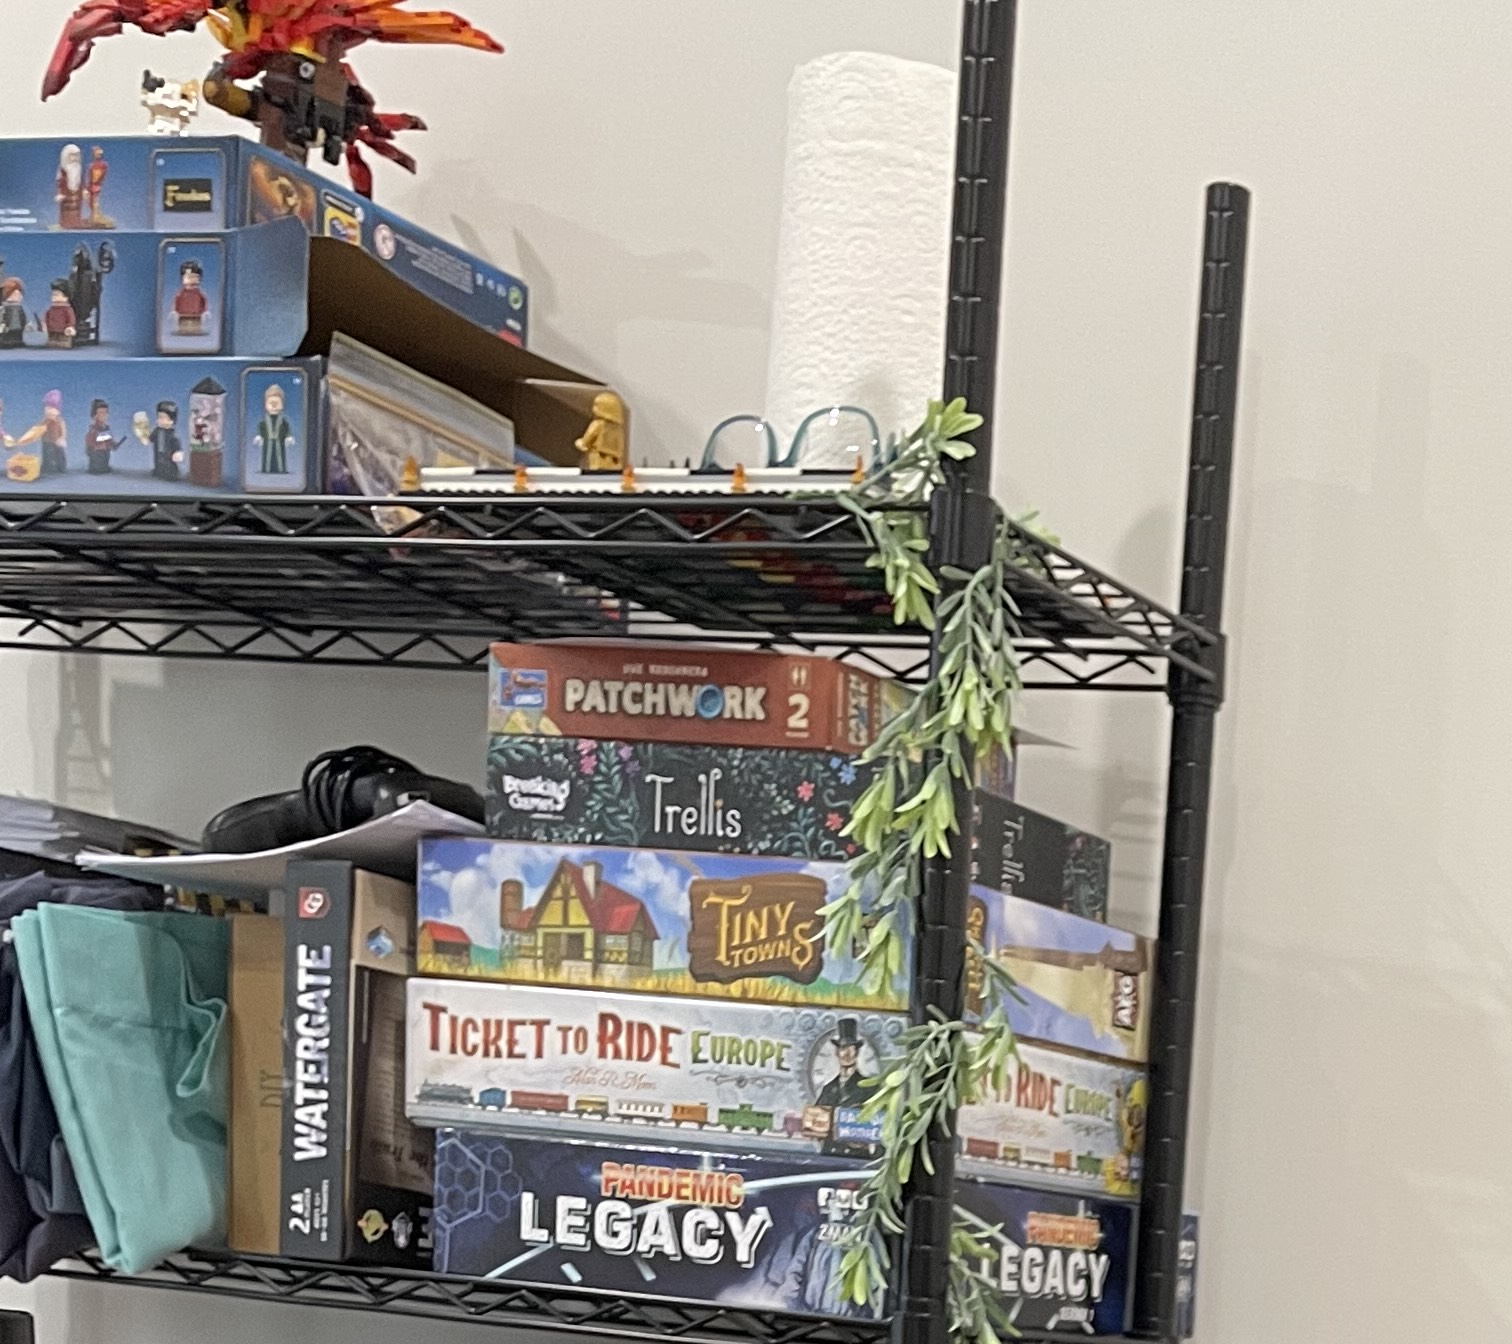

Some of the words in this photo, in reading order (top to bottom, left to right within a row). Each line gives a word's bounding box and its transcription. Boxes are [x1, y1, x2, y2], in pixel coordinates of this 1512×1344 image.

[565, 678, 767, 721] PATCHWORK
[787, 693, 810, 729] 2
[645, 768, 742, 839] Trellis
[702, 884, 796, 967] TINY
[730, 919, 815, 970] TOWNS
[293, 944, 332, 1162] WATERGATE
[423, 1002, 551, 1059] TICKET
[557, 1025, 588, 1055] TO
[597, 1012, 684, 1068] RIDE
[691, 1030, 792, 1072] EUROPE
[601, 1161, 745, 1209] PANDEMIC
[288, 1217, 311, 1234] 2
[519, 1191, 773, 1269] LEGACY
[980, 1243, 1110, 1303] LEGACY
